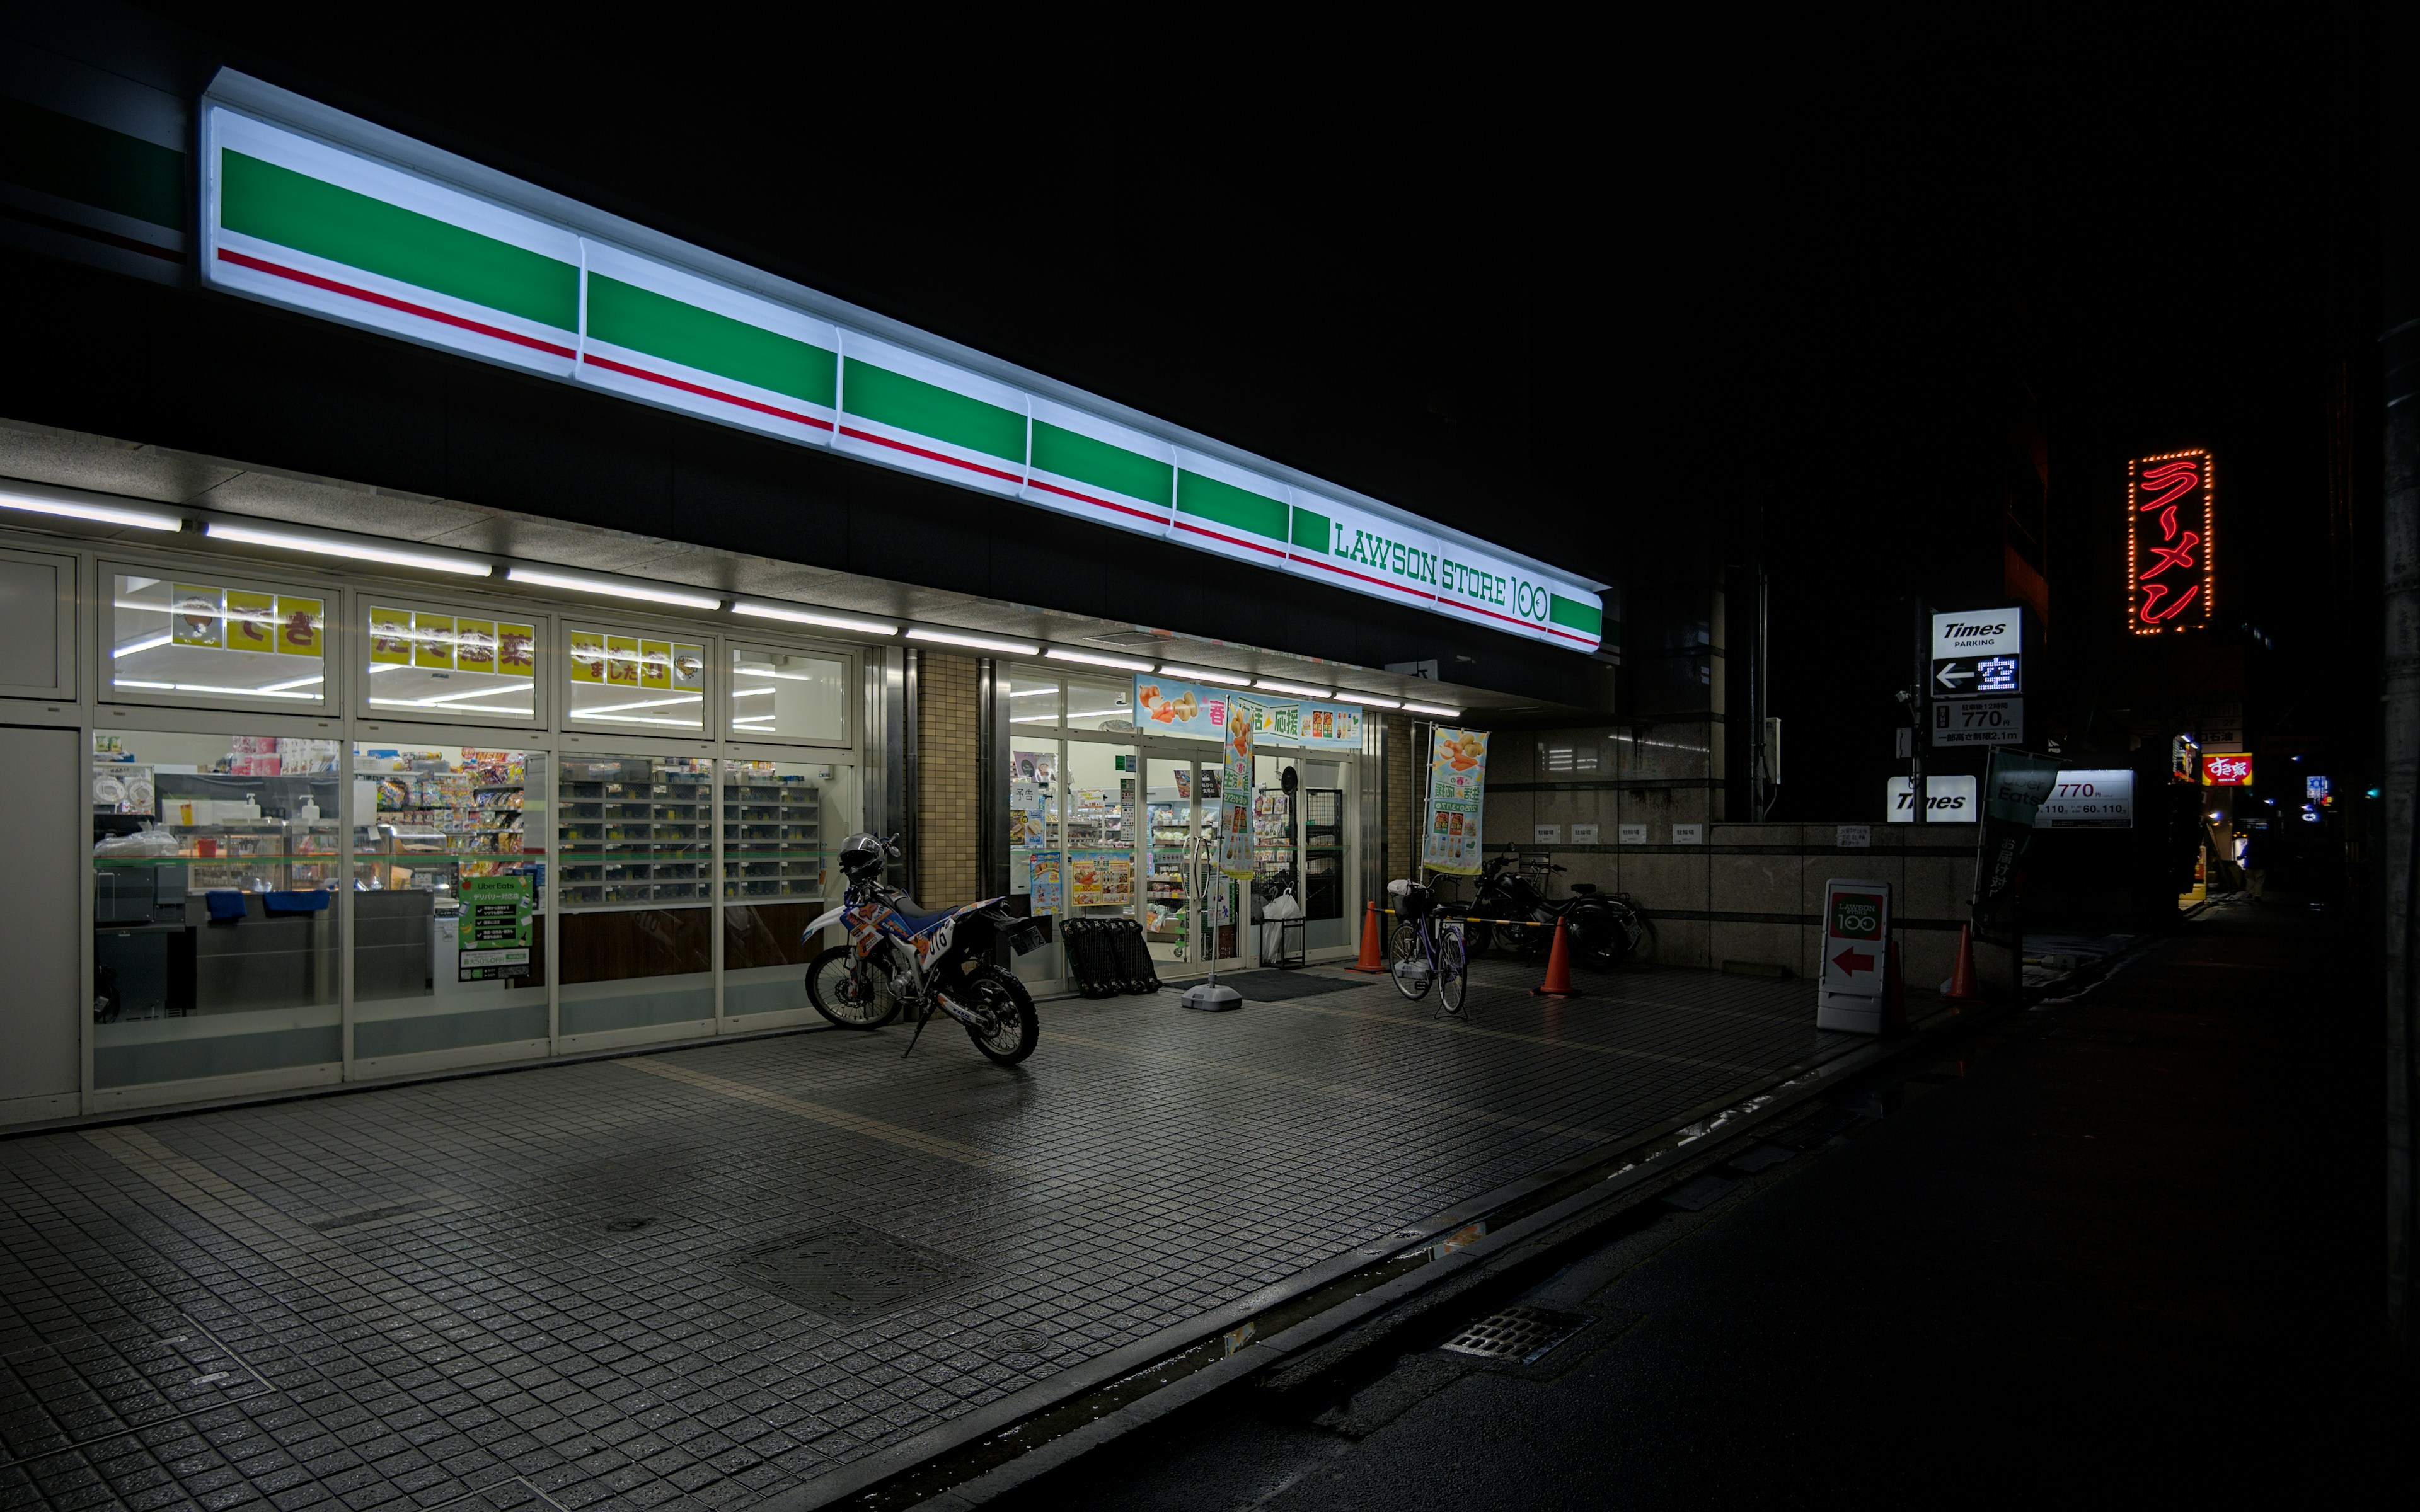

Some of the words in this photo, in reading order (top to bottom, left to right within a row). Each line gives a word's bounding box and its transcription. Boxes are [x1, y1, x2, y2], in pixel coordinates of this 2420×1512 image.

[2139, 461, 2200, 624] ラーメン
[1334, 522, 1437, 585] LAWSON
[1442, 558, 1507, 606] STORE
[1511, 576, 1548, 622] 100
[1944, 622, 2007, 639] Times
[1954, 639, 1995, 648] PARKING
[1977, 657, 2017, 691] 空
[477, 751, 505, 762] NEW
[2207, 757, 2247, 779] すき家
[1016, 788, 1034, 801] 予告
[1998, 786, 2041, 807] Eats
[1988, 837, 2016, 898] お届け対
[473, 893, 519, 901] デリバリー対応店
[1838, 903, 1876, 912] LAWSON
[1838, 914, 1877, 932] 100
